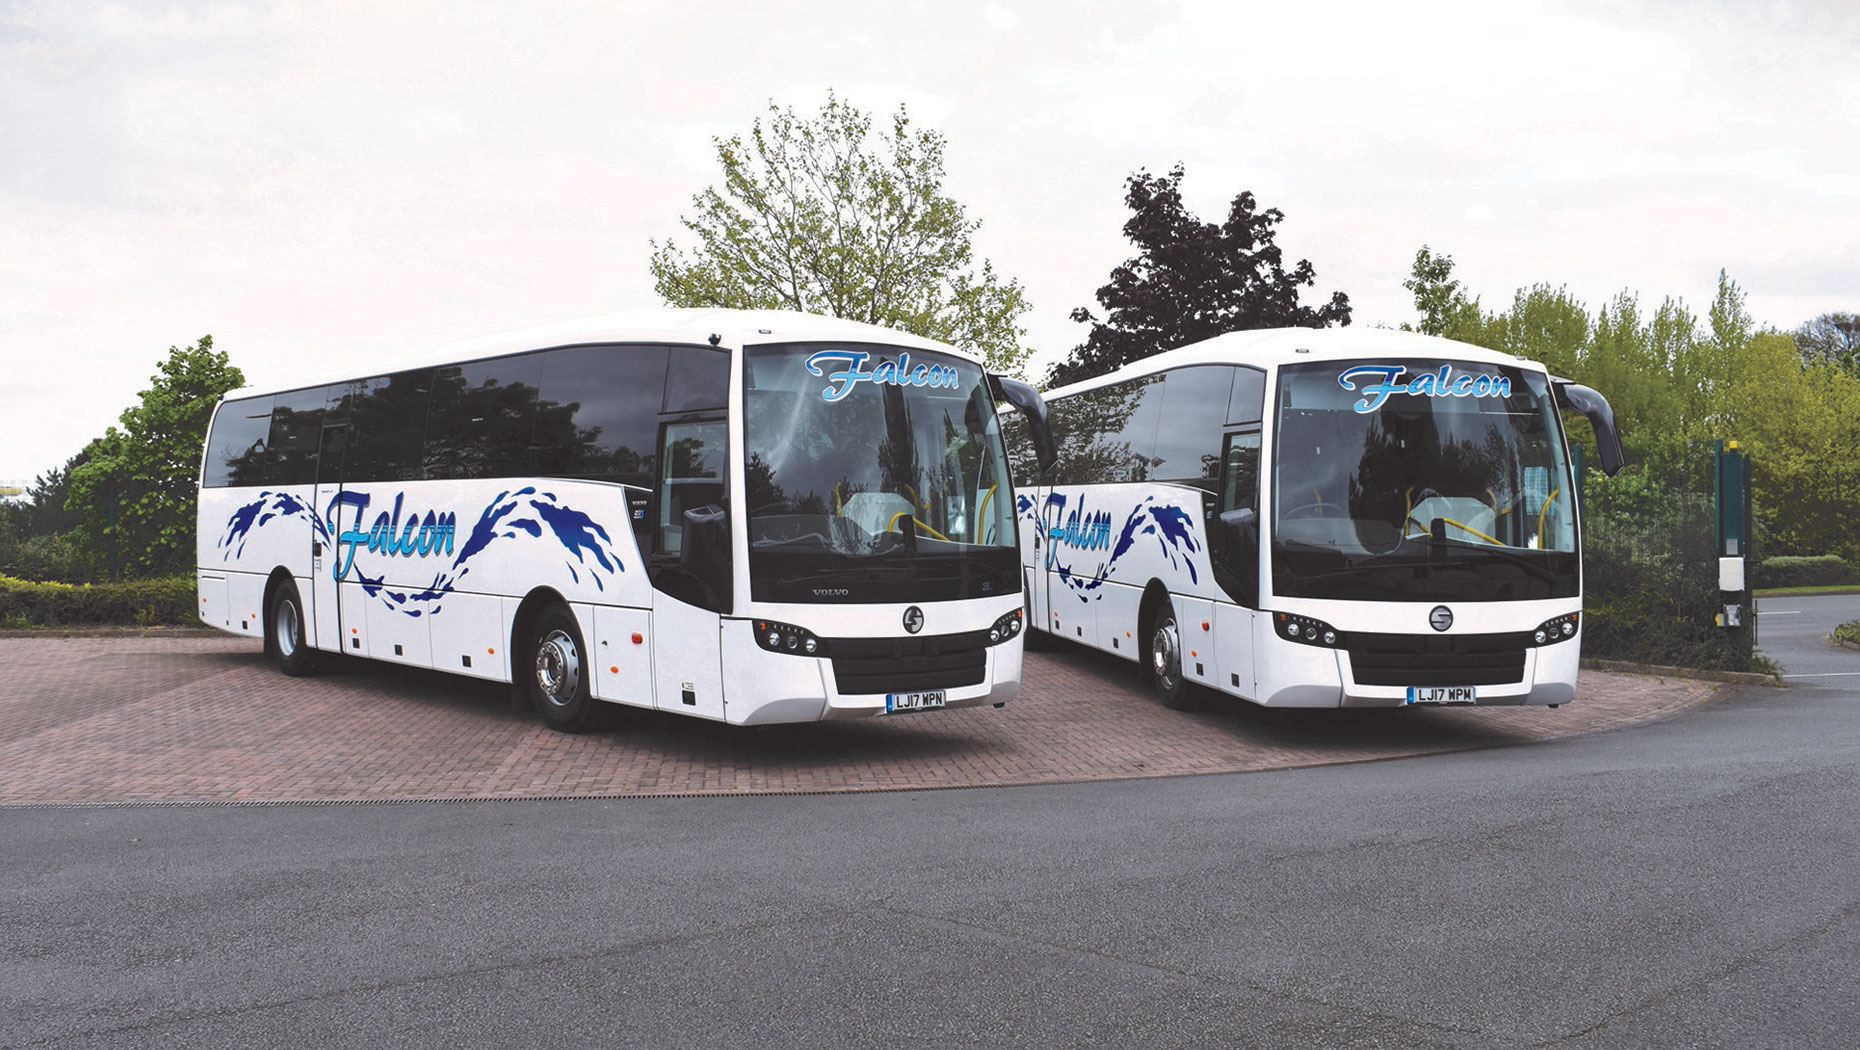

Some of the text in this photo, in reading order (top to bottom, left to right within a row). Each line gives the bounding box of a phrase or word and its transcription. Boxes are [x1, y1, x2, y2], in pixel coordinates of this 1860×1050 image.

[805, 350, 959, 402] Falcon
[1338, 364, 1512, 414] Falcon
[326, 490, 456, 581] Falcon
[1042, 492, 1111, 571] Falcon
[812, 588, 849, 596] VOLVO
[896, 692, 942, 708] LJ17 WPN
[1418, 688, 1471, 701] LJ17 WPM
